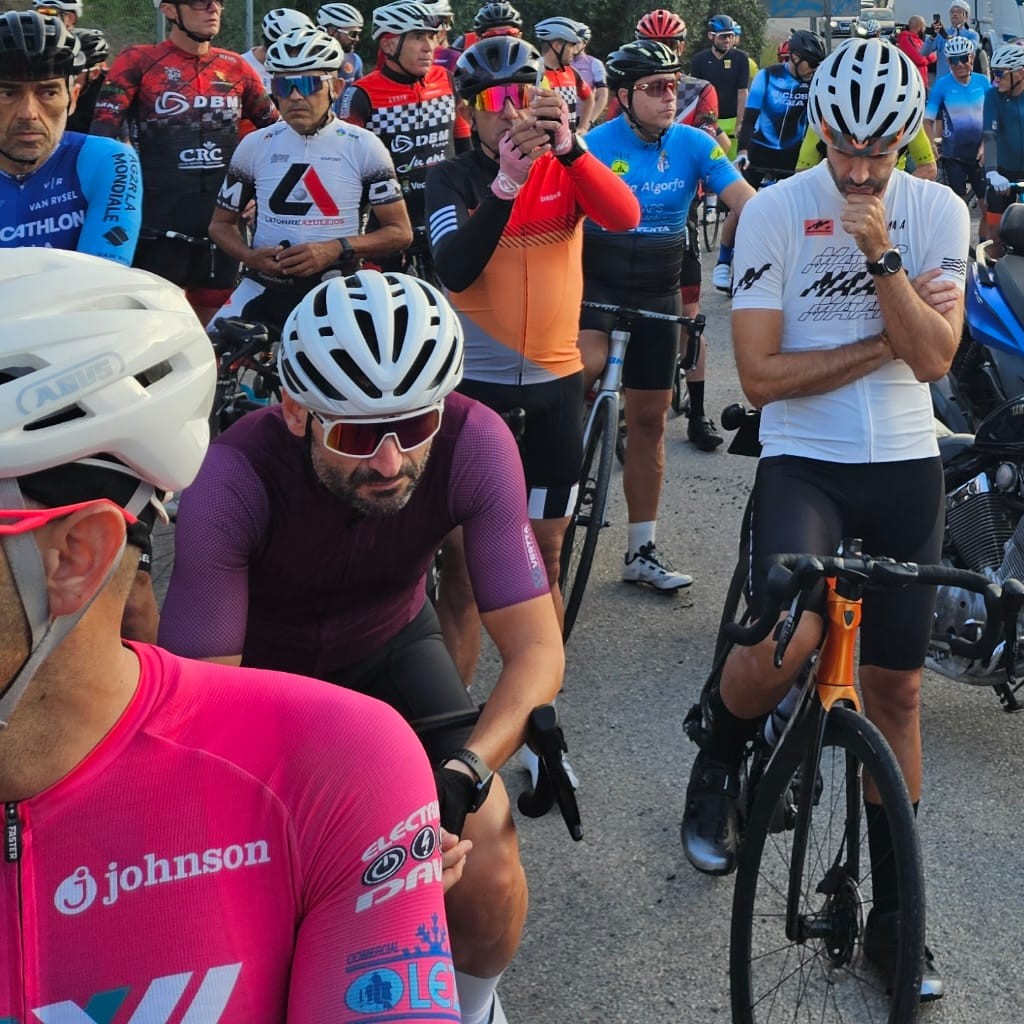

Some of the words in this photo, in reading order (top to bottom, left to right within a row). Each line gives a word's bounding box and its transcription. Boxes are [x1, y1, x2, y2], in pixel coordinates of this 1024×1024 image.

[415, 129, 449, 147] DBM
[179, 147, 223, 163] CRC
[102, 152, 129, 223] MONDIALE
[642, 178, 685, 194] Algorfa
[29, 199, 49, 212] VAN
[51, 190, 79, 205] RYSEL
[8, 825, 19, 860] FASTER
[102, 839, 271, 906] johnson
